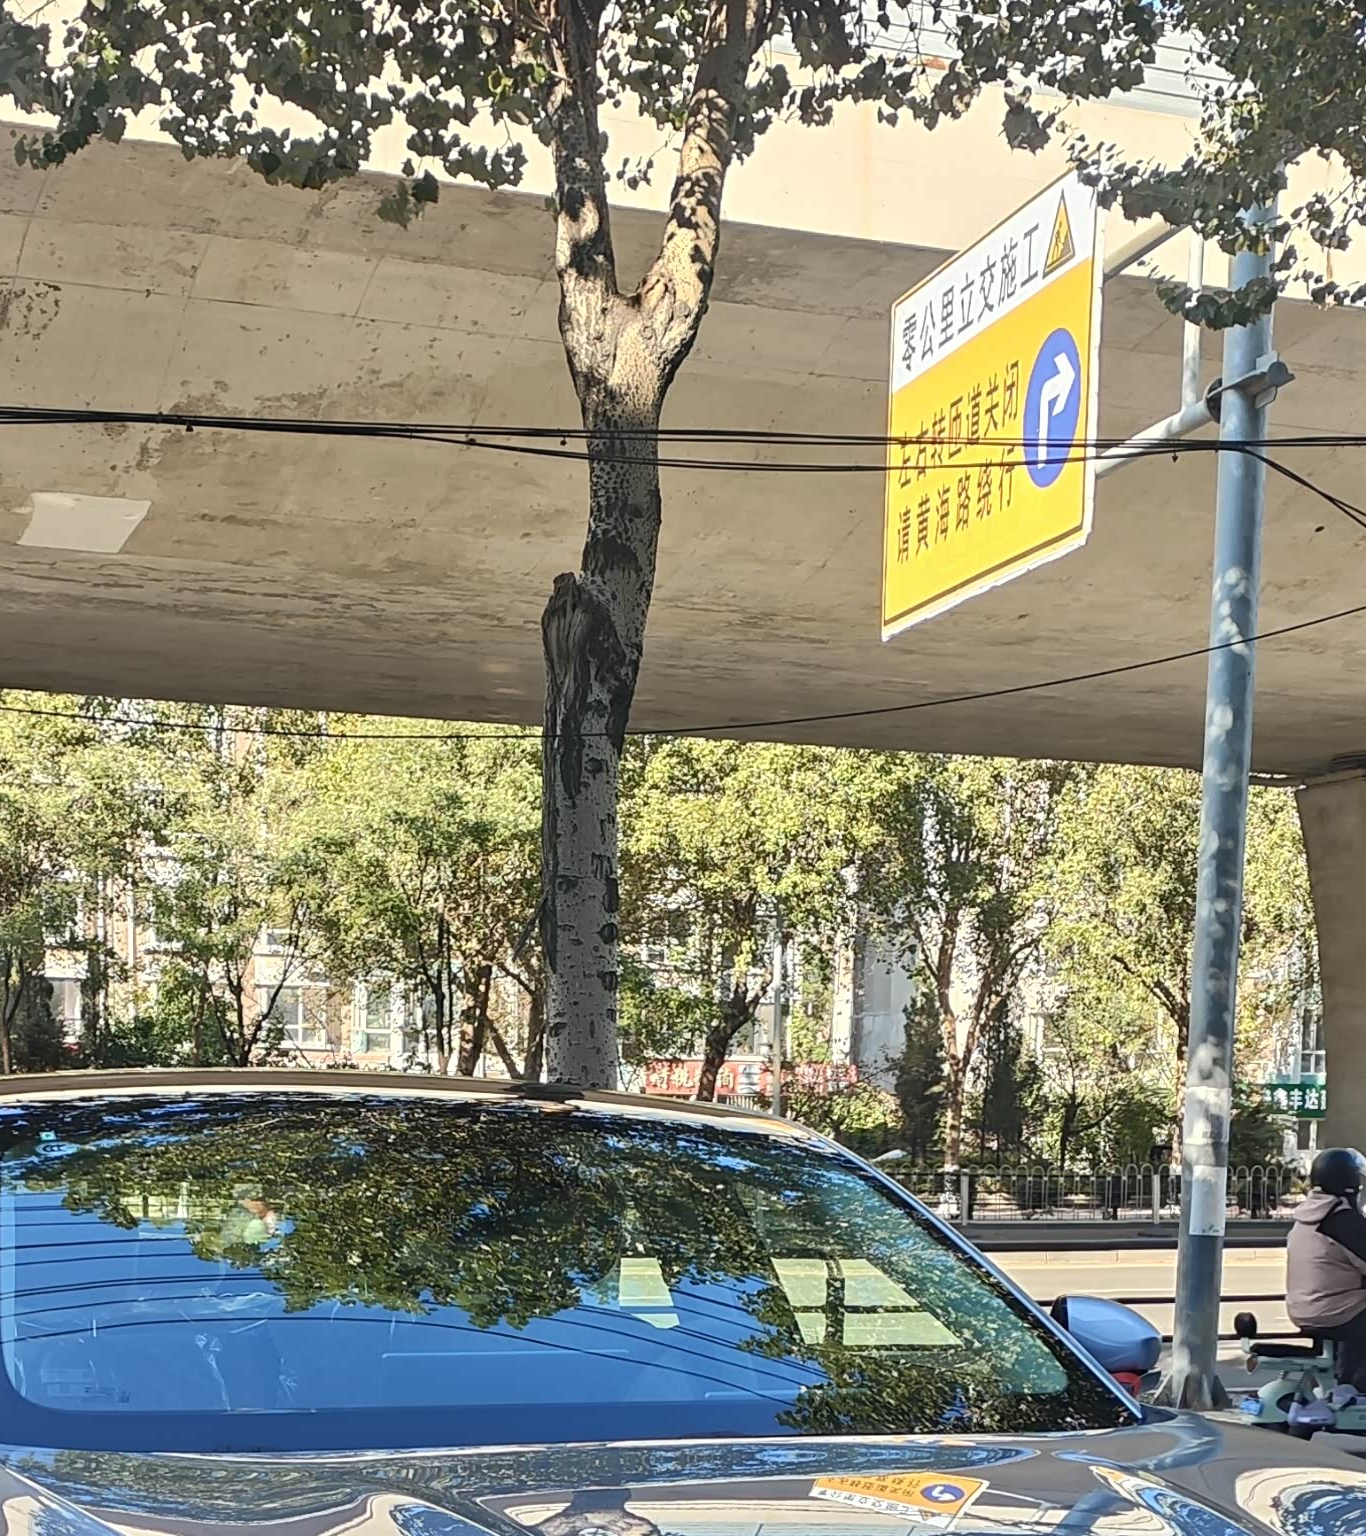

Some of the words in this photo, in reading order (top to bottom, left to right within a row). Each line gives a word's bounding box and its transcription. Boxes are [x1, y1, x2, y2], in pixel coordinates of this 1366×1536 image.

[901, 222, 1040, 372] 零公里立交施工
[897, 359, 1020, 489] 左右转匝道关闭
[896, 444, 1016, 564] 请黄海路绕行
